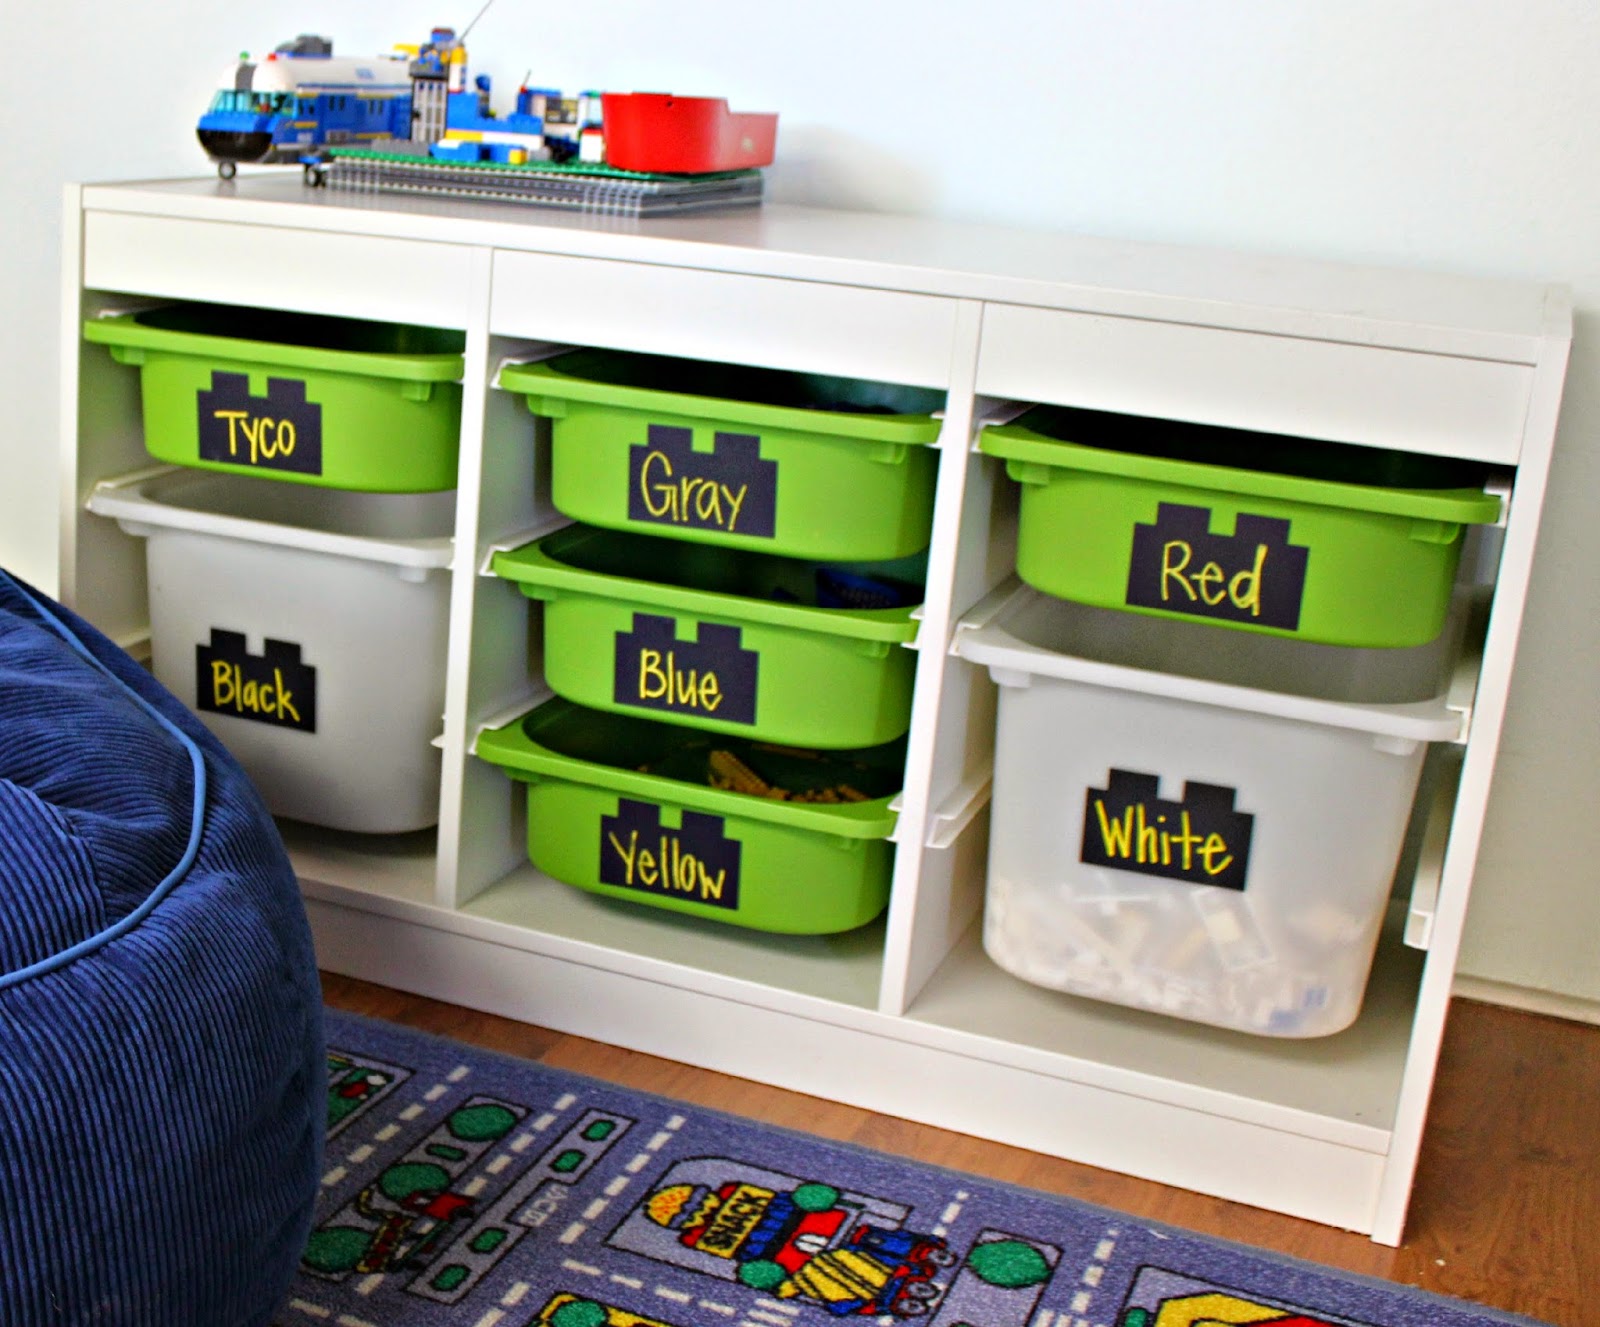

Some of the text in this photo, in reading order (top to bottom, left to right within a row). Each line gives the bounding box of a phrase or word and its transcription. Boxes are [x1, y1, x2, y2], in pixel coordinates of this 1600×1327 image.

[213, 409, 296, 464] Tyco
[641, 450, 748, 532] Gray
[1162, 540, 1268, 618] Red
[211, 661, 301, 722] Black
[638, 648, 723, 712] Blue
[606, 831, 727, 900] Yellow
[1093, 800, 1234, 876] White
[702, 1190, 769, 1250] SNACK
